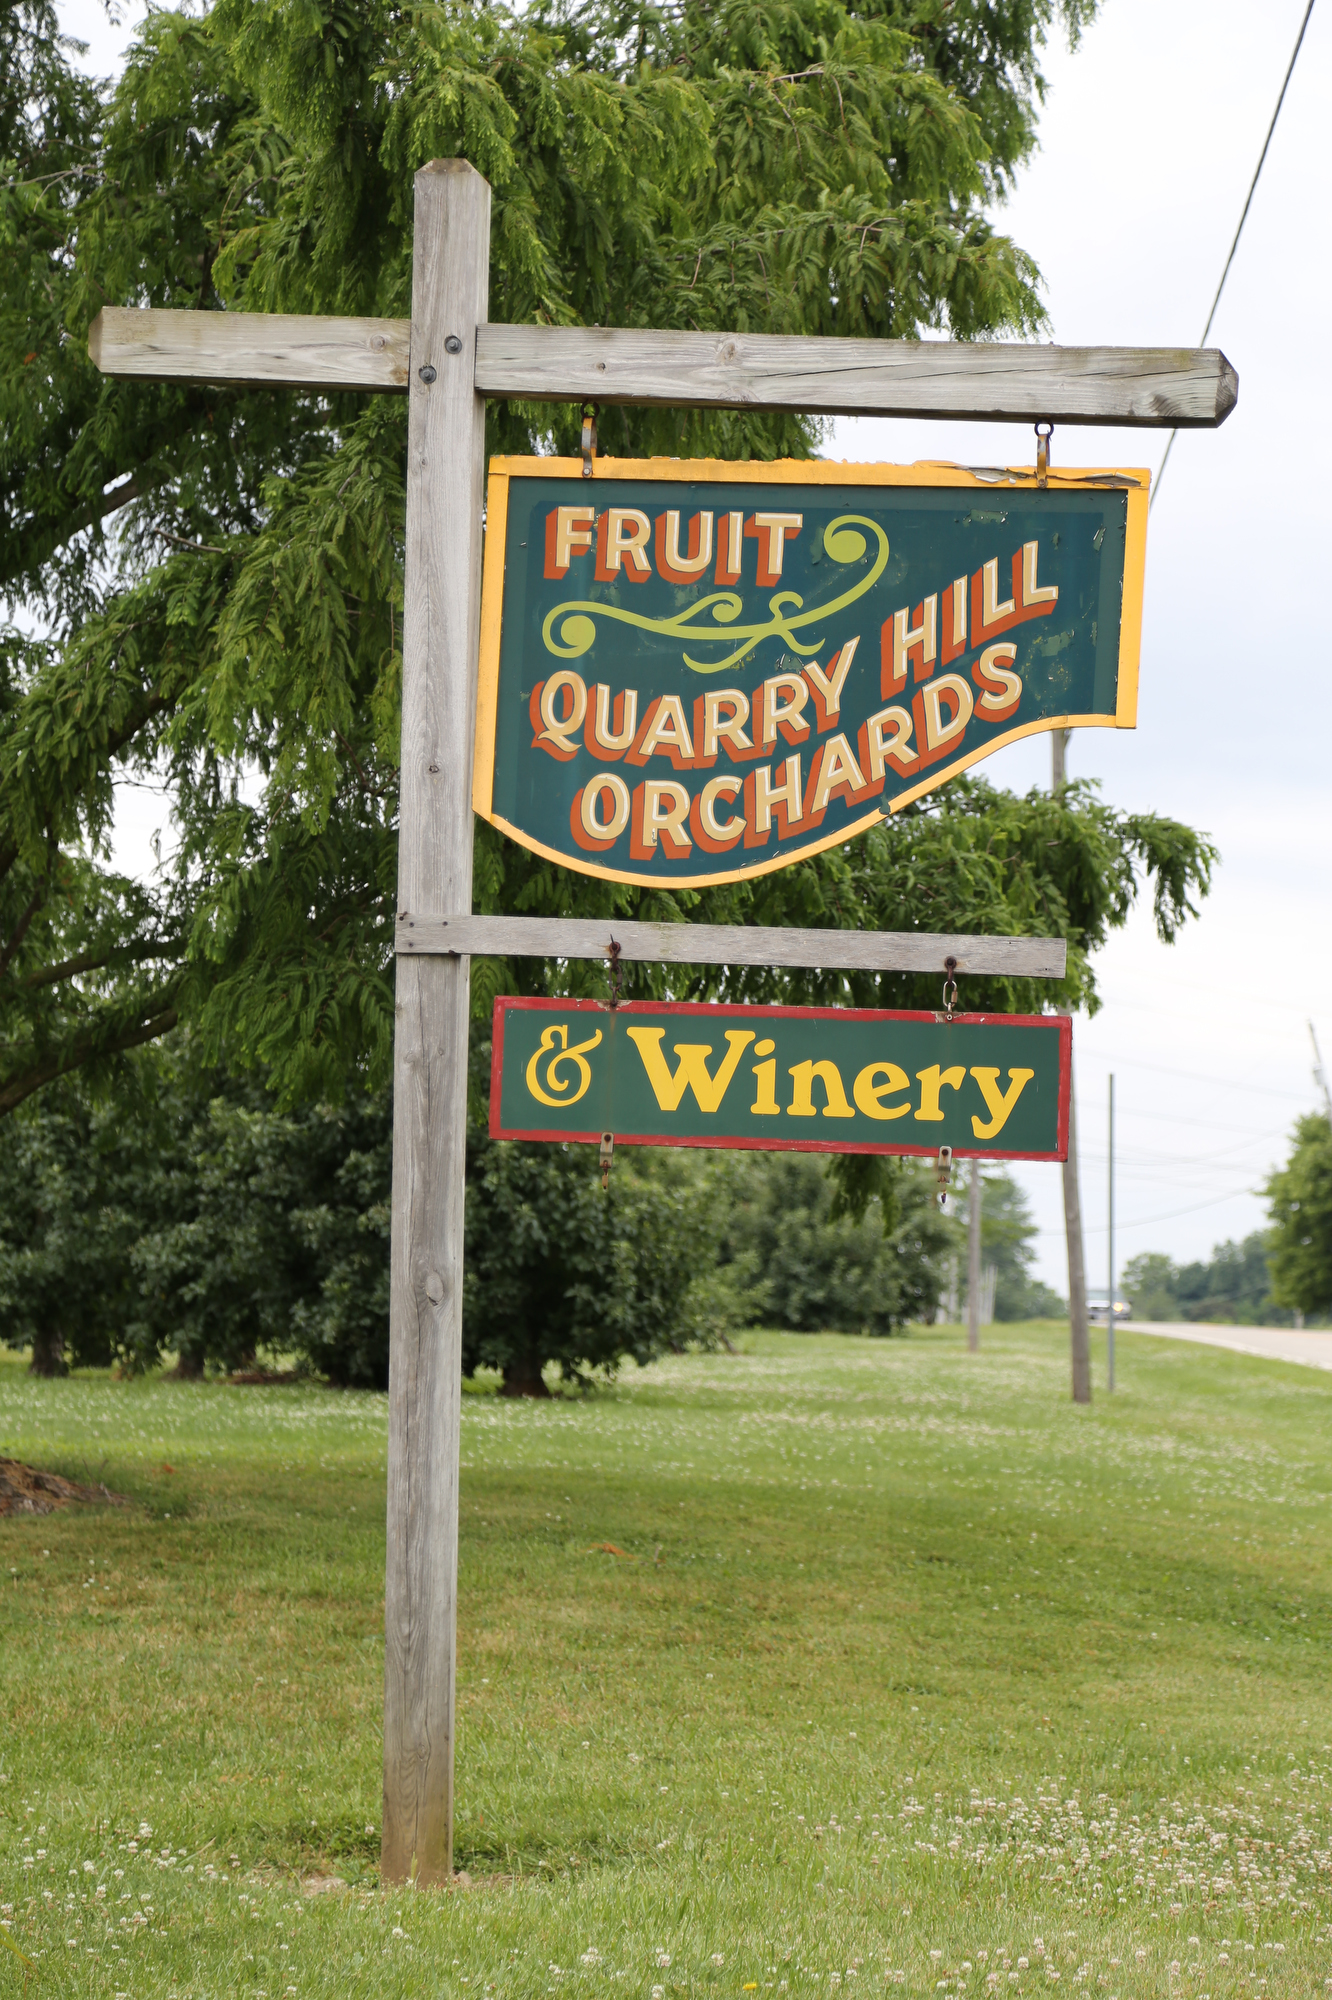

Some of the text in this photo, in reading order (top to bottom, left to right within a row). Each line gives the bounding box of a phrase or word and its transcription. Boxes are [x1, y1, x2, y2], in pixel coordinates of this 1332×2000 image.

[543, 506, 803, 587] FRUIT
[529, 540, 1059, 770] QUARRY HILL
[570, 641, 1022, 860] ORCHARDS
[525, 1024, 1035, 1140] & Winery
